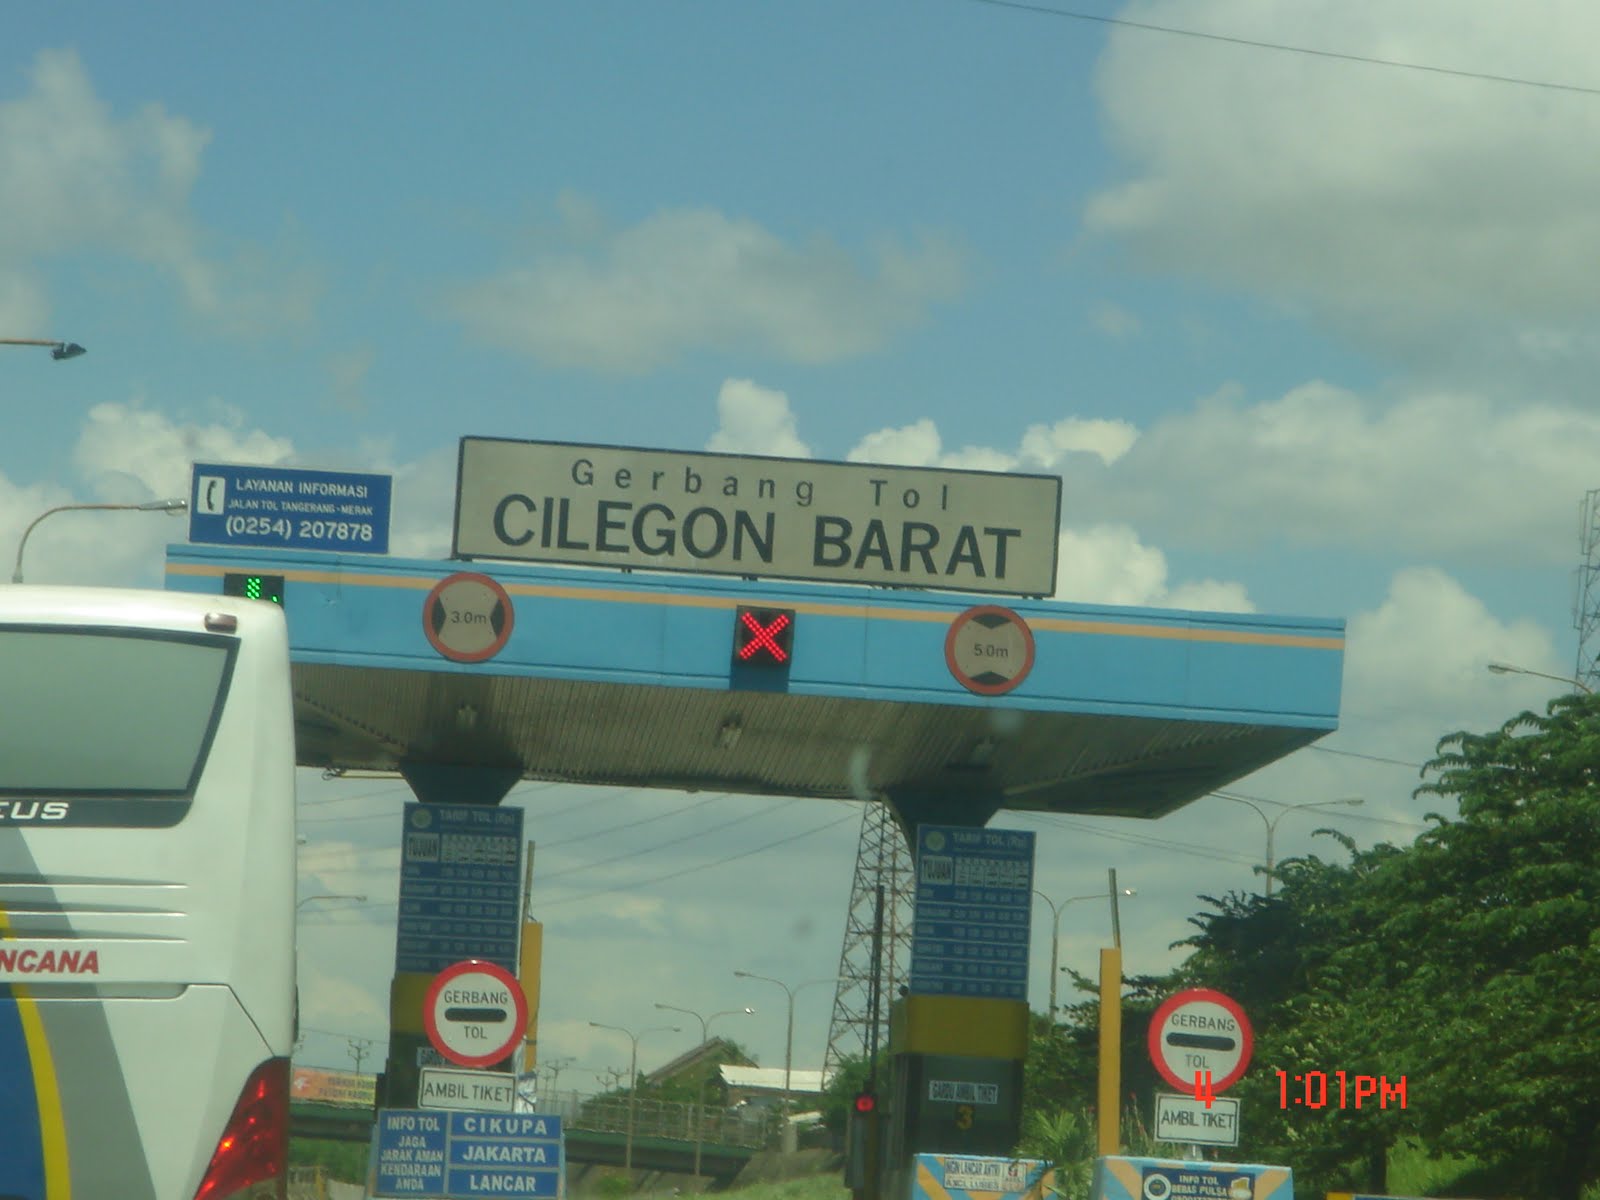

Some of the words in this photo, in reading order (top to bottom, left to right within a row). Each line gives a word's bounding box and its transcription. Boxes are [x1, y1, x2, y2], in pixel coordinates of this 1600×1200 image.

[236, 478, 294, 493] LAYANAN
[299, 481, 368, 498] INFORMASI
[571, 458, 814, 507] Gerbang
[870, 479, 949, 511] Tol
[228, 499, 259, 510] JALAN
[261, 500, 279, 511] TOL
[226, 515, 292, 540] (0254)
[299, 520, 373, 542] 207878
[493, 493, 776, 564] CILEGON
[813, 514, 1022, 580] BARAT
[444, 990, 508, 1005] GERBANG
[1171, 1013, 1235, 1031] GERBANG
[464, 1025, 488, 1040] TOL
[1185, 1053, 1210, 1070] TOL
[424, 1082, 468, 1099] AMBIL
[472, 1084, 512, 1103] TIKET
[387, 1116, 415, 1131] INFO
[419, 1117, 440, 1132] TOL
[463, 1117, 547, 1135] CIKUPA
[1161, 1110, 1199, 1127] AMBIL
[1202, 1112, 1235, 1129] TIKET
[399, 1136, 427, 1148] JAGA
[381, 1149, 413, 1162] JARAK
[415, 1150, 444, 1163] AMAN
[462, 1145, 547, 1163] JAKARTA
[380, 1163, 441, 1177] KENDARAAN
[395, 1178, 424, 1191] ANDA
[470, 1174, 536, 1192] LANCAR
[1179, 1175, 1200, 1184] INFO
[1202, 1176, 1219, 1186] TOL
[1171, 1184, 1197, 1195] BEBAS
[1199, 1185, 1228, 1197] PULSA
